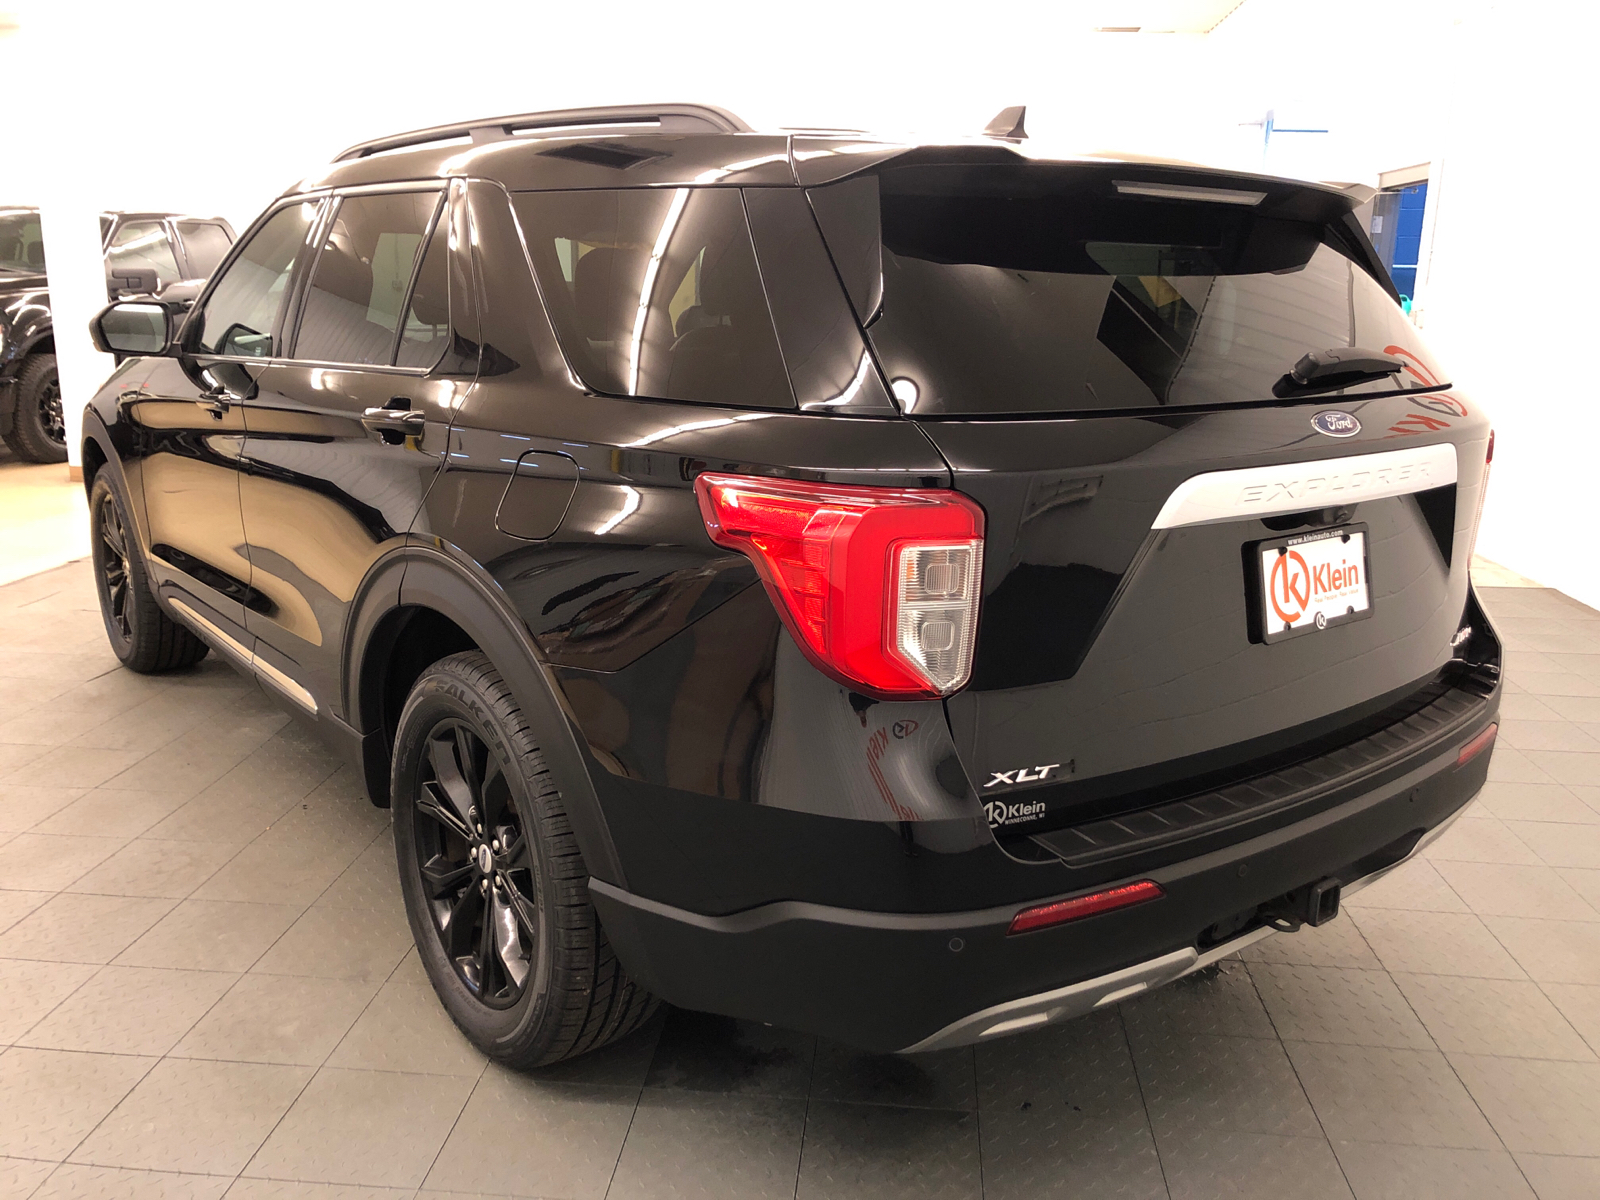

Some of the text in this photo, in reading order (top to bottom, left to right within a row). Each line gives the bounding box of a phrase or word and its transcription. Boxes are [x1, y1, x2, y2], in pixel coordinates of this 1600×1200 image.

[1325, 414, 1354, 430] Ford
[1235, 461, 1432, 504] EXPLORER
[1287, 530, 1343, 545] www.kleinauto.com
[1313, 559, 1358, 595] Klein
[983, 764, 1060, 787] XLT
[1008, 801, 1045, 817] Klein
